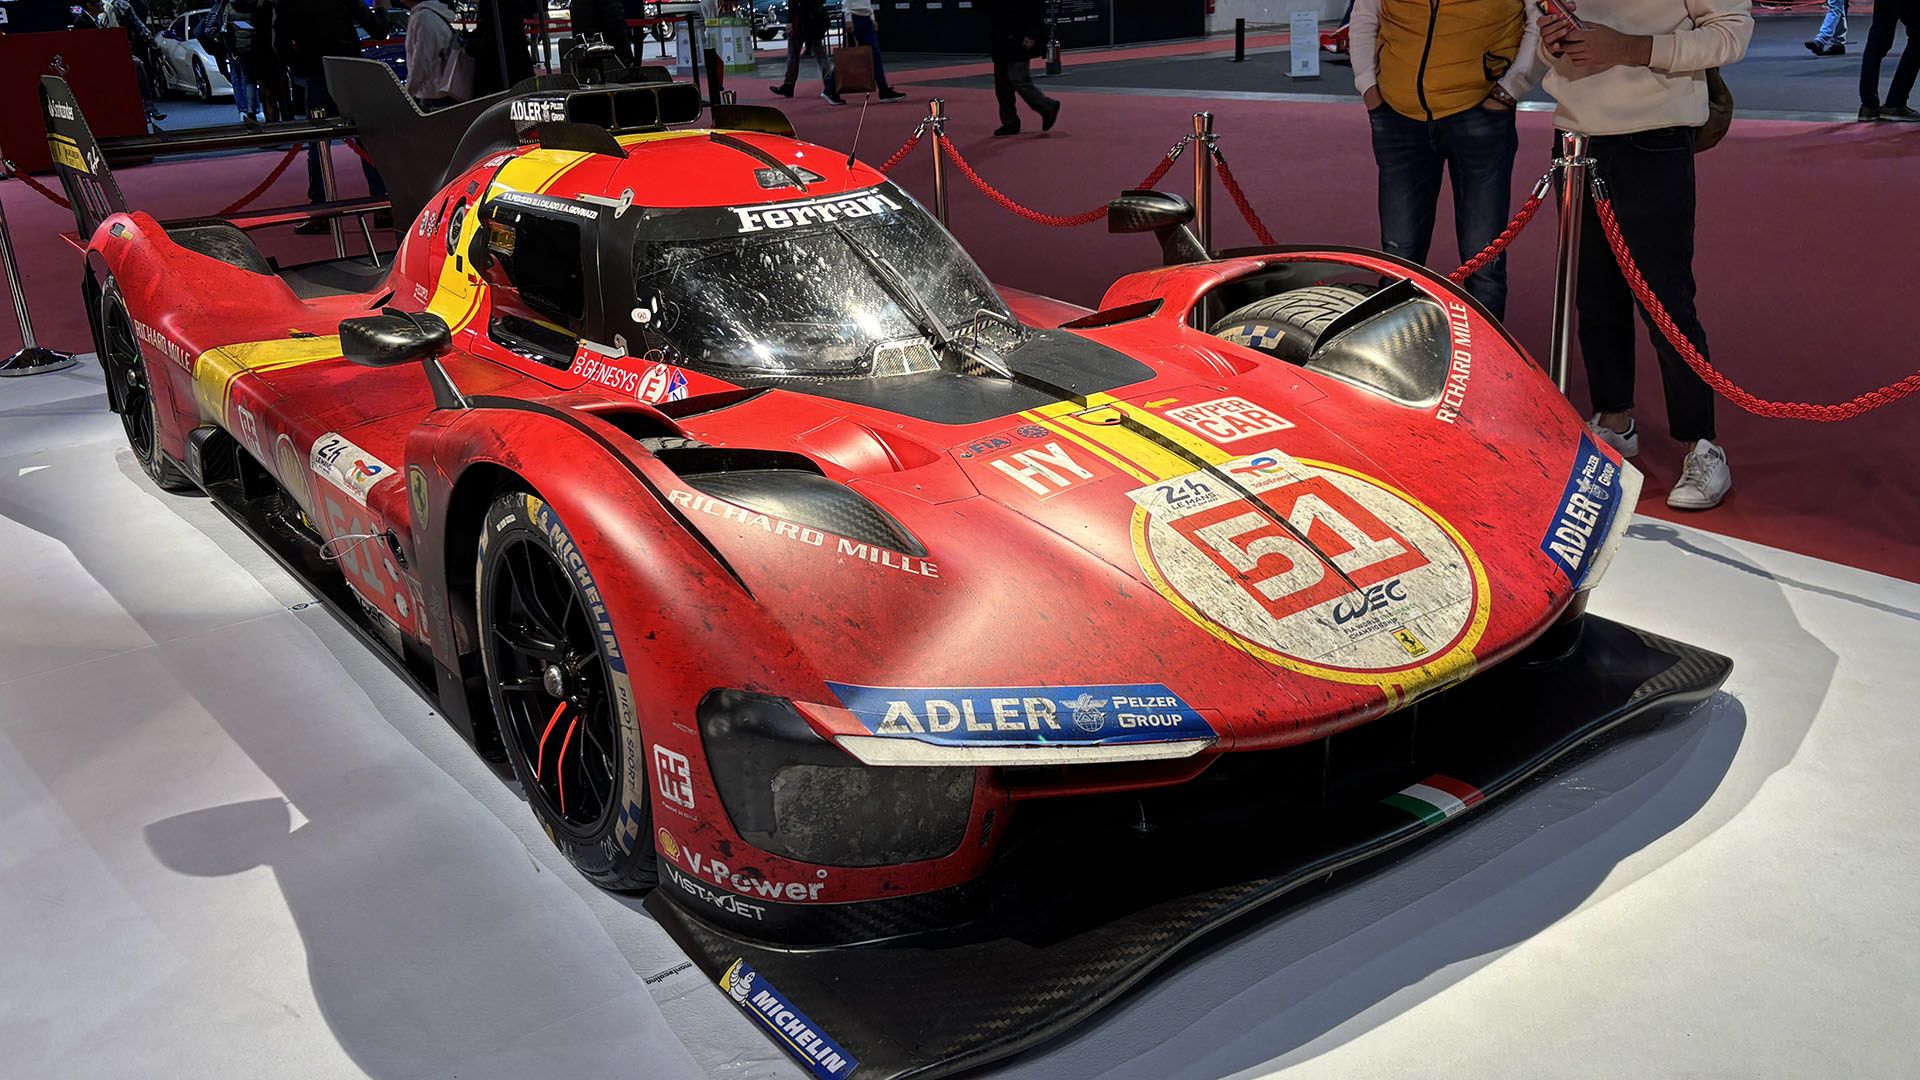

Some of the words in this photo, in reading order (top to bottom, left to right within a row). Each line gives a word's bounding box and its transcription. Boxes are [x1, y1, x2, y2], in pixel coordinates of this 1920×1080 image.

[510, 101, 541, 120] ADLER
[733, 188, 903, 233] Ferrari
[134, 319, 169, 355] RICHARD
[167, 340, 191, 373] MILLE
[1449, 301, 1472, 348] MILLE
[582, 359, 639, 392] GENESYS
[1435, 350, 1472, 424] RICHARD
[1173, 399, 1254, 422] HYPER
[1196, 409, 1287, 439] CAR
[969, 438, 1009, 454] FIA
[989, 441, 1095, 496] HY
[1156, 478, 1211, 504] 24h
[1171, 501, 1186, 510] LE
[1185, 491, 1217, 506] MANS
[668, 489, 825, 547] RICHARD
[837, 538, 940, 579] MILLE
[1194, 493, 1409, 602] 51
[1549, 492, 1602, 571] ADLER
[550, 522, 621, 659] MICHELIN
[1333, 579, 1408, 625] WEC
[1344, 627, 1357, 635] FIA
[1356, 617, 1381, 630] WORLD
[876, 697, 1061, 736] ADLER
[1112, 696, 1178, 710] PELZER
[1118, 713, 1183, 729] GROUP
[618, 686, 633, 738] PILOT
[626, 738, 638, 794] SPORT
[682, 846, 825, 901] V-Power
[752, 989, 847, 1074] MICHELIN
